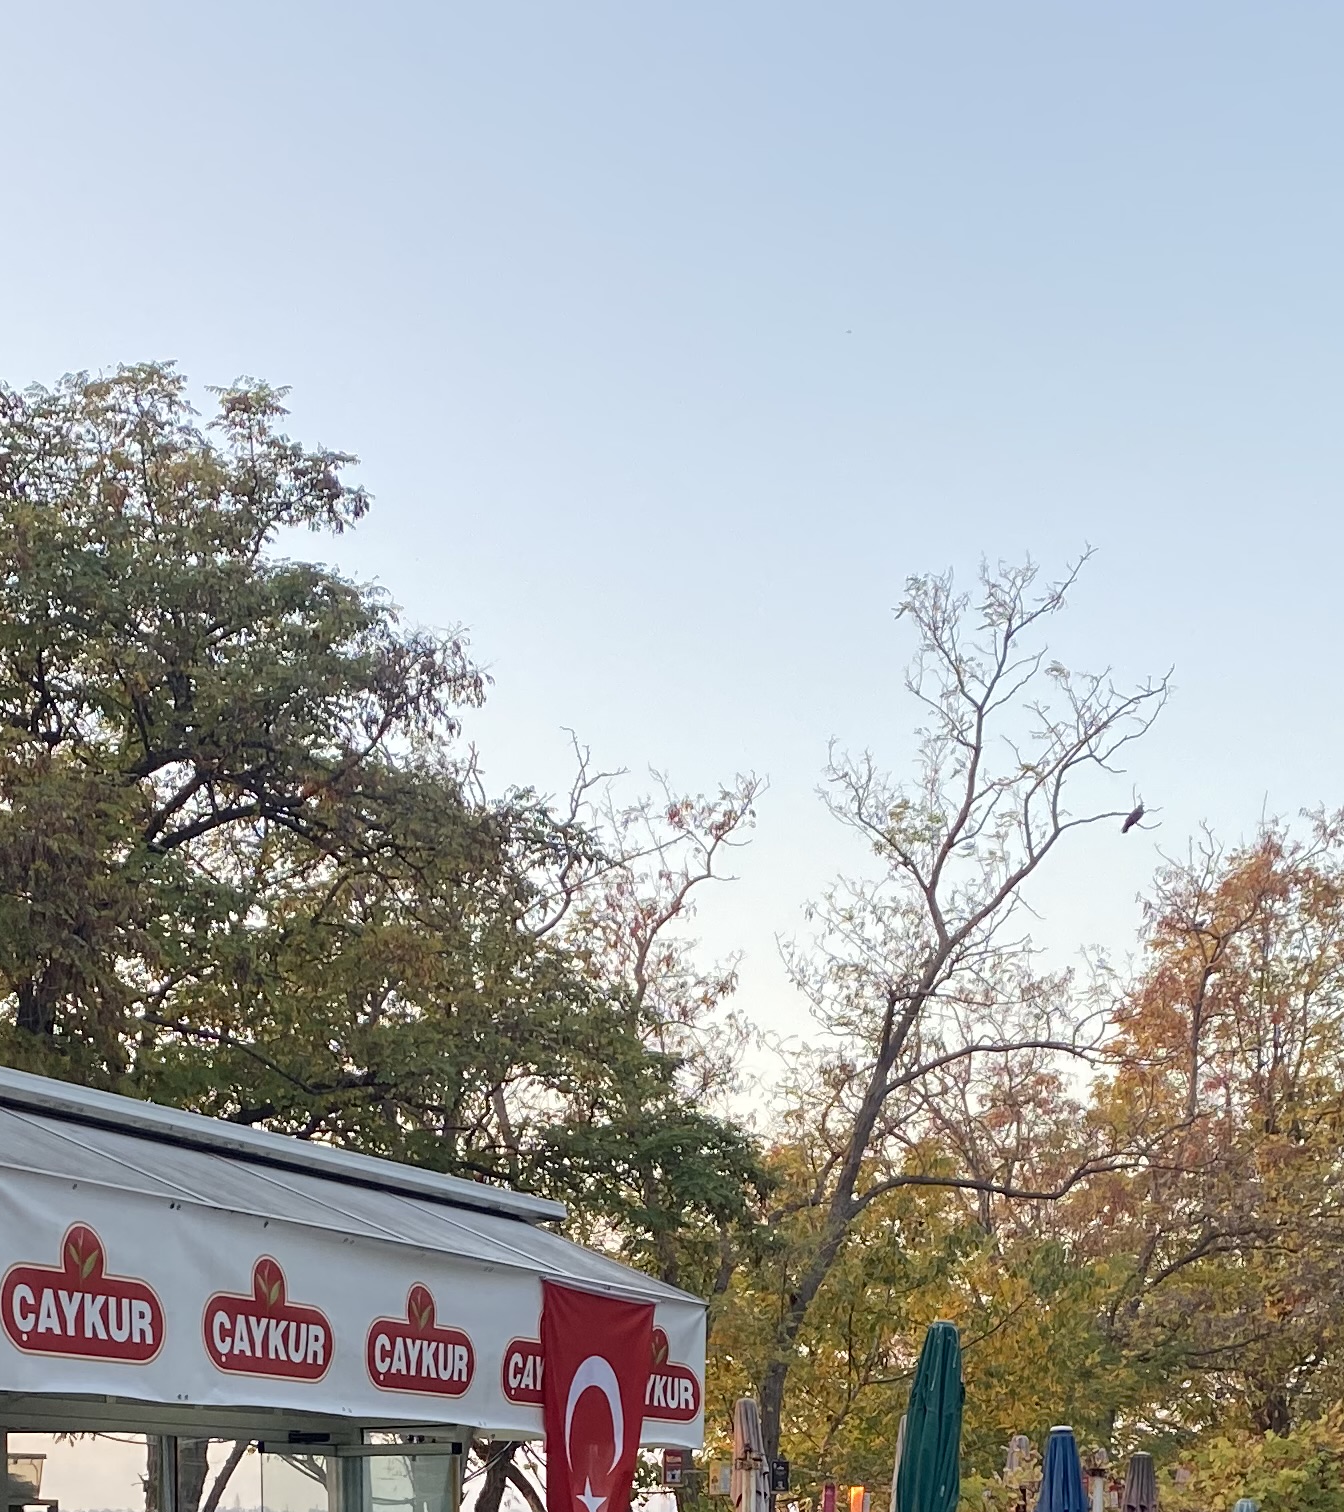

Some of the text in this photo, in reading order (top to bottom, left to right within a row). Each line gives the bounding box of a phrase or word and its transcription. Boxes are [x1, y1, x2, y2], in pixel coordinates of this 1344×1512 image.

[12, 1283, 154, 1345] ÇAYKUR
[212, 1310, 326, 1365] ÇAYKUR
[374, 1333, 468, 1383] ÇAYKUR
[508, 1352, 545, 1396] ÇAY
